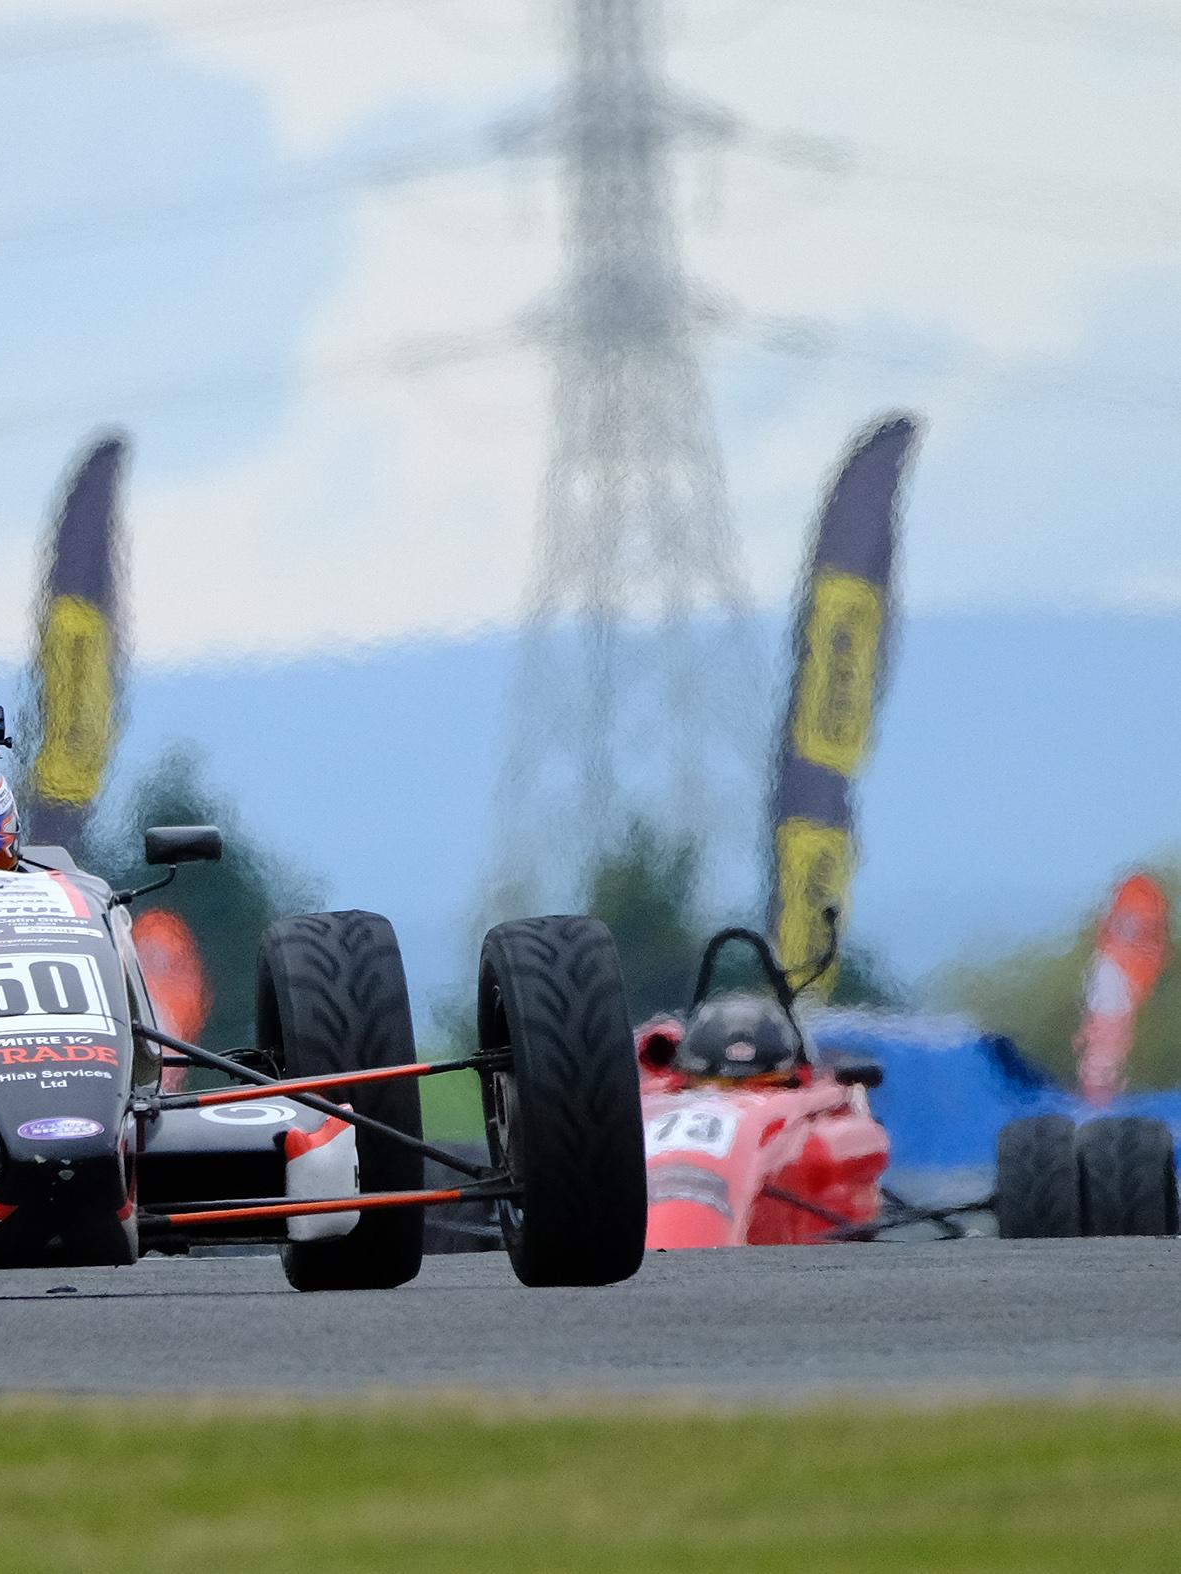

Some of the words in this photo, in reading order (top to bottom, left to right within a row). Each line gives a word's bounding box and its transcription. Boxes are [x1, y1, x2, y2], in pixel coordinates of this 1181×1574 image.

[65, 1035, 93, 1044] 10
[41, 1068, 113, 1080] Services
[41, 1079, 68, 1089] Ltd
